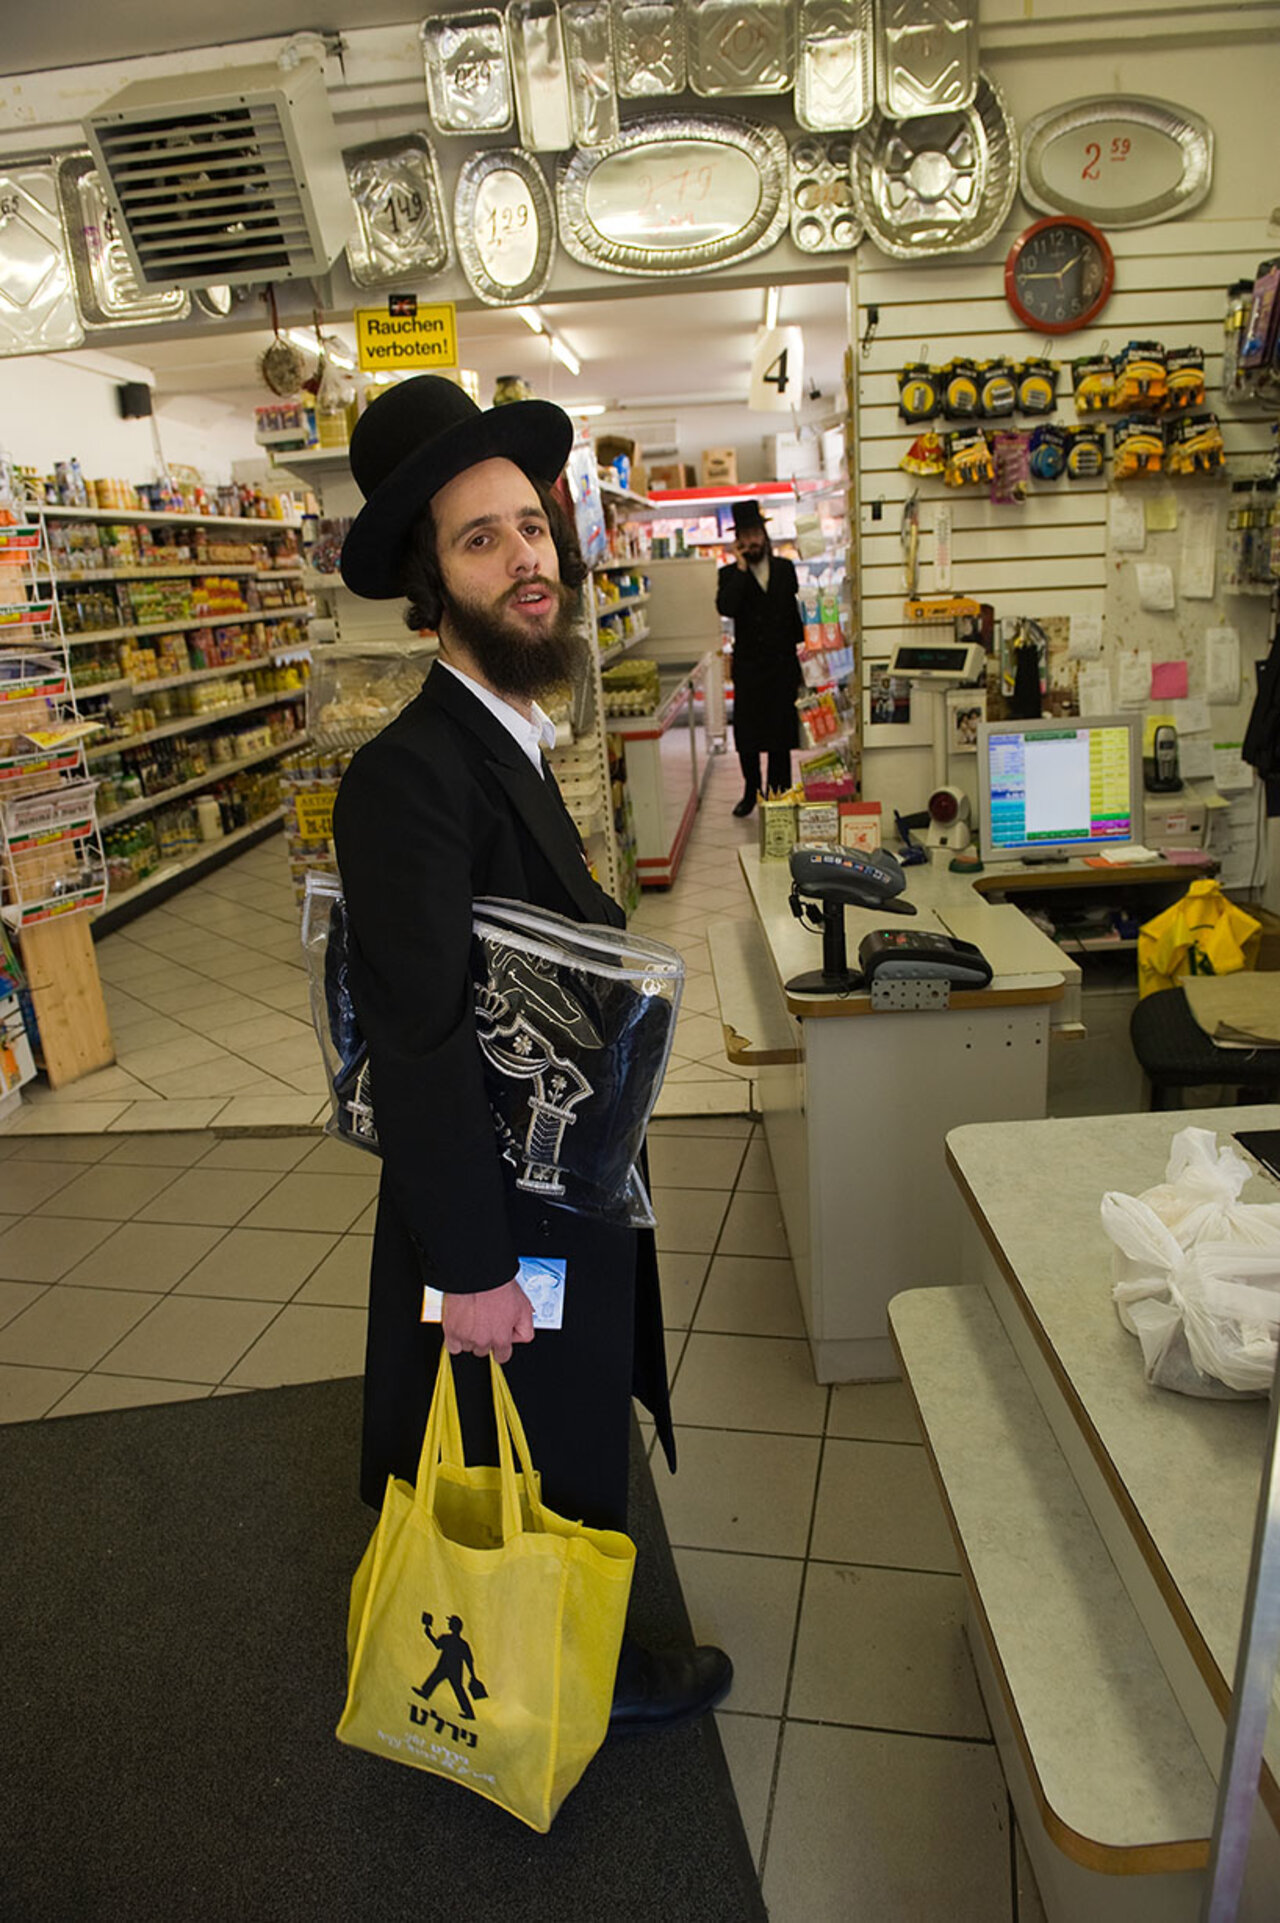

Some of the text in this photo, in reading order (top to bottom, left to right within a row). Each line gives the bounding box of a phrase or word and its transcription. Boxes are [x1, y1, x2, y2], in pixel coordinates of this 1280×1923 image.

[1082, 143, 1101, 180] 2
[1034, 240, 1047, 254] 11
[1050, 230, 1064, 246] 12
[1022, 255, 1036, 271] 10
[367, 316, 444, 335] Rauchen
[366, 338, 448, 358] verboten!
[763, 347, 789, 393] 4
[409, 1703, 478, 1748] נירלט
